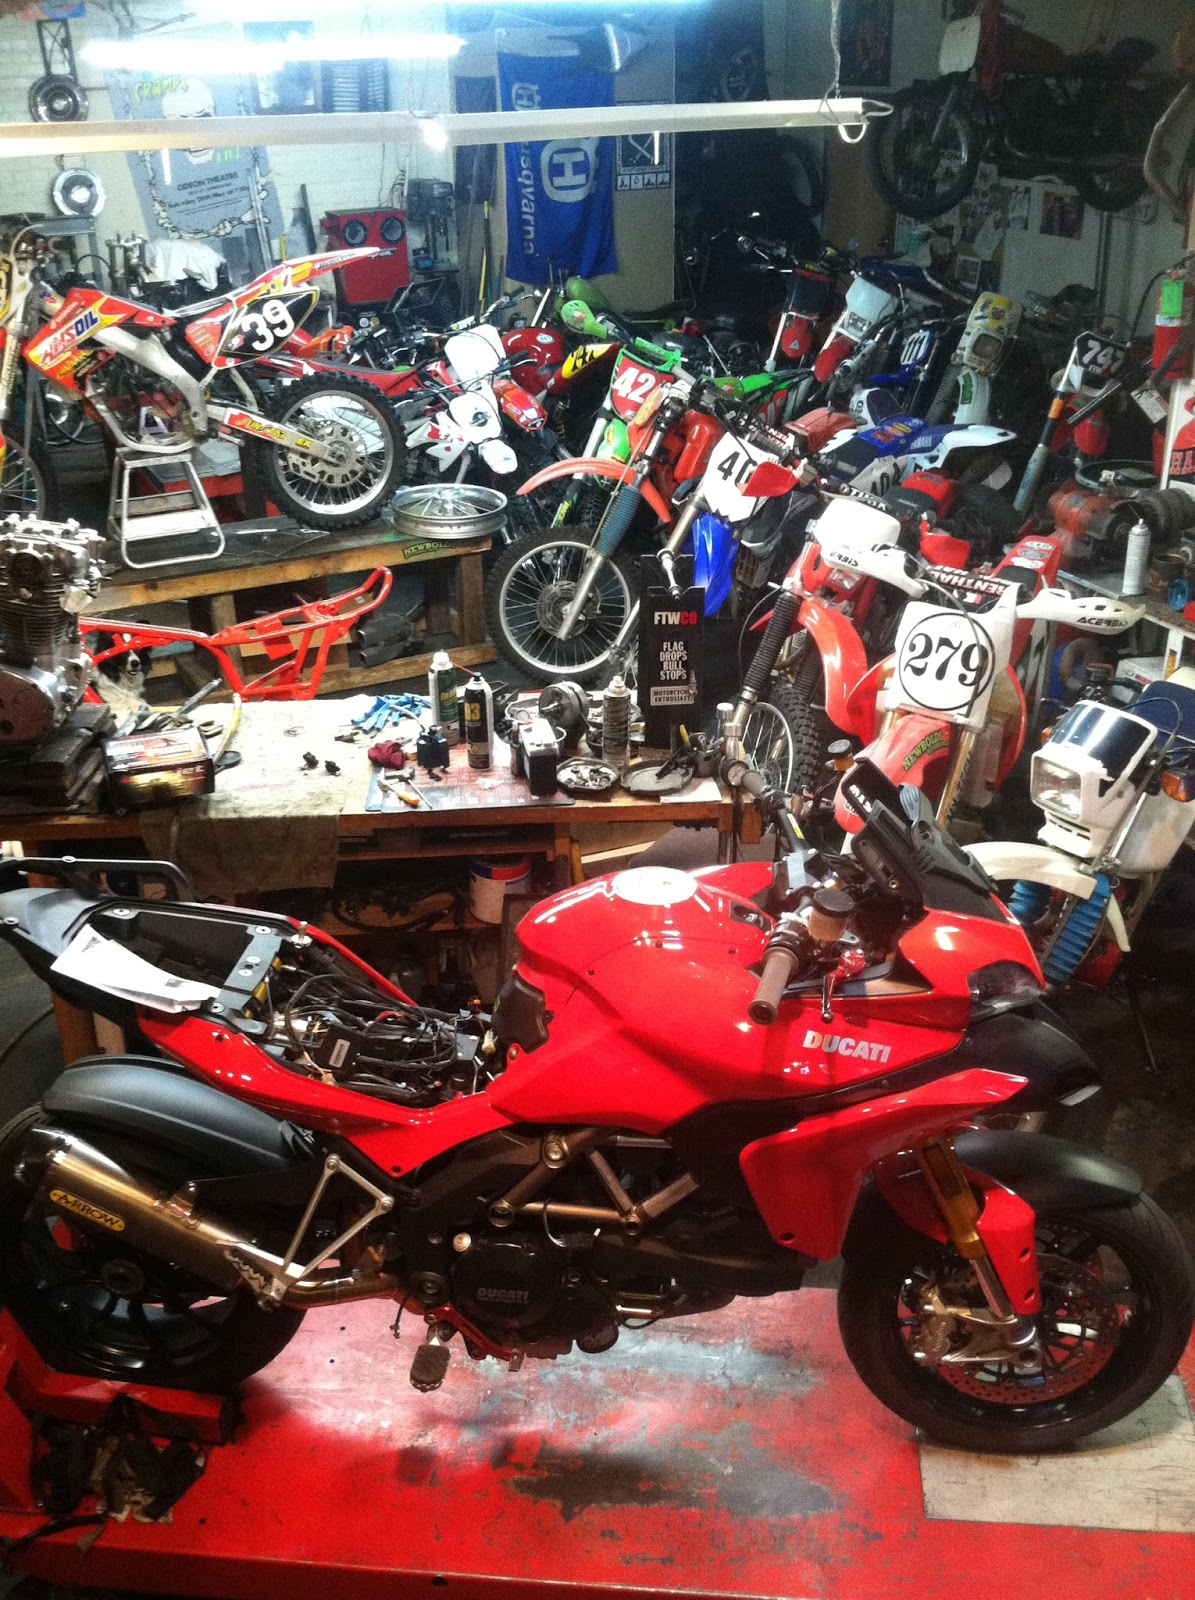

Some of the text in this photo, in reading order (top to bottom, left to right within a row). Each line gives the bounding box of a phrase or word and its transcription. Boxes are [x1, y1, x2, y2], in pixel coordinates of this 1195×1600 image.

[518, 141, 536, 256] usqvarna
[241, 299, 296, 352] 39
[611, 366, 656, 404] 42
[659, 650, 688, 661] DROPS
[663, 641, 684, 651] FLAG
[903, 632, 989, 687] 279
[660, 670, 687, 680] STOPS
[663, 660, 684, 670] BULL
[802, 1029, 892, 1064] DUCATI
[57, 1194, 119, 1226] ARROW
